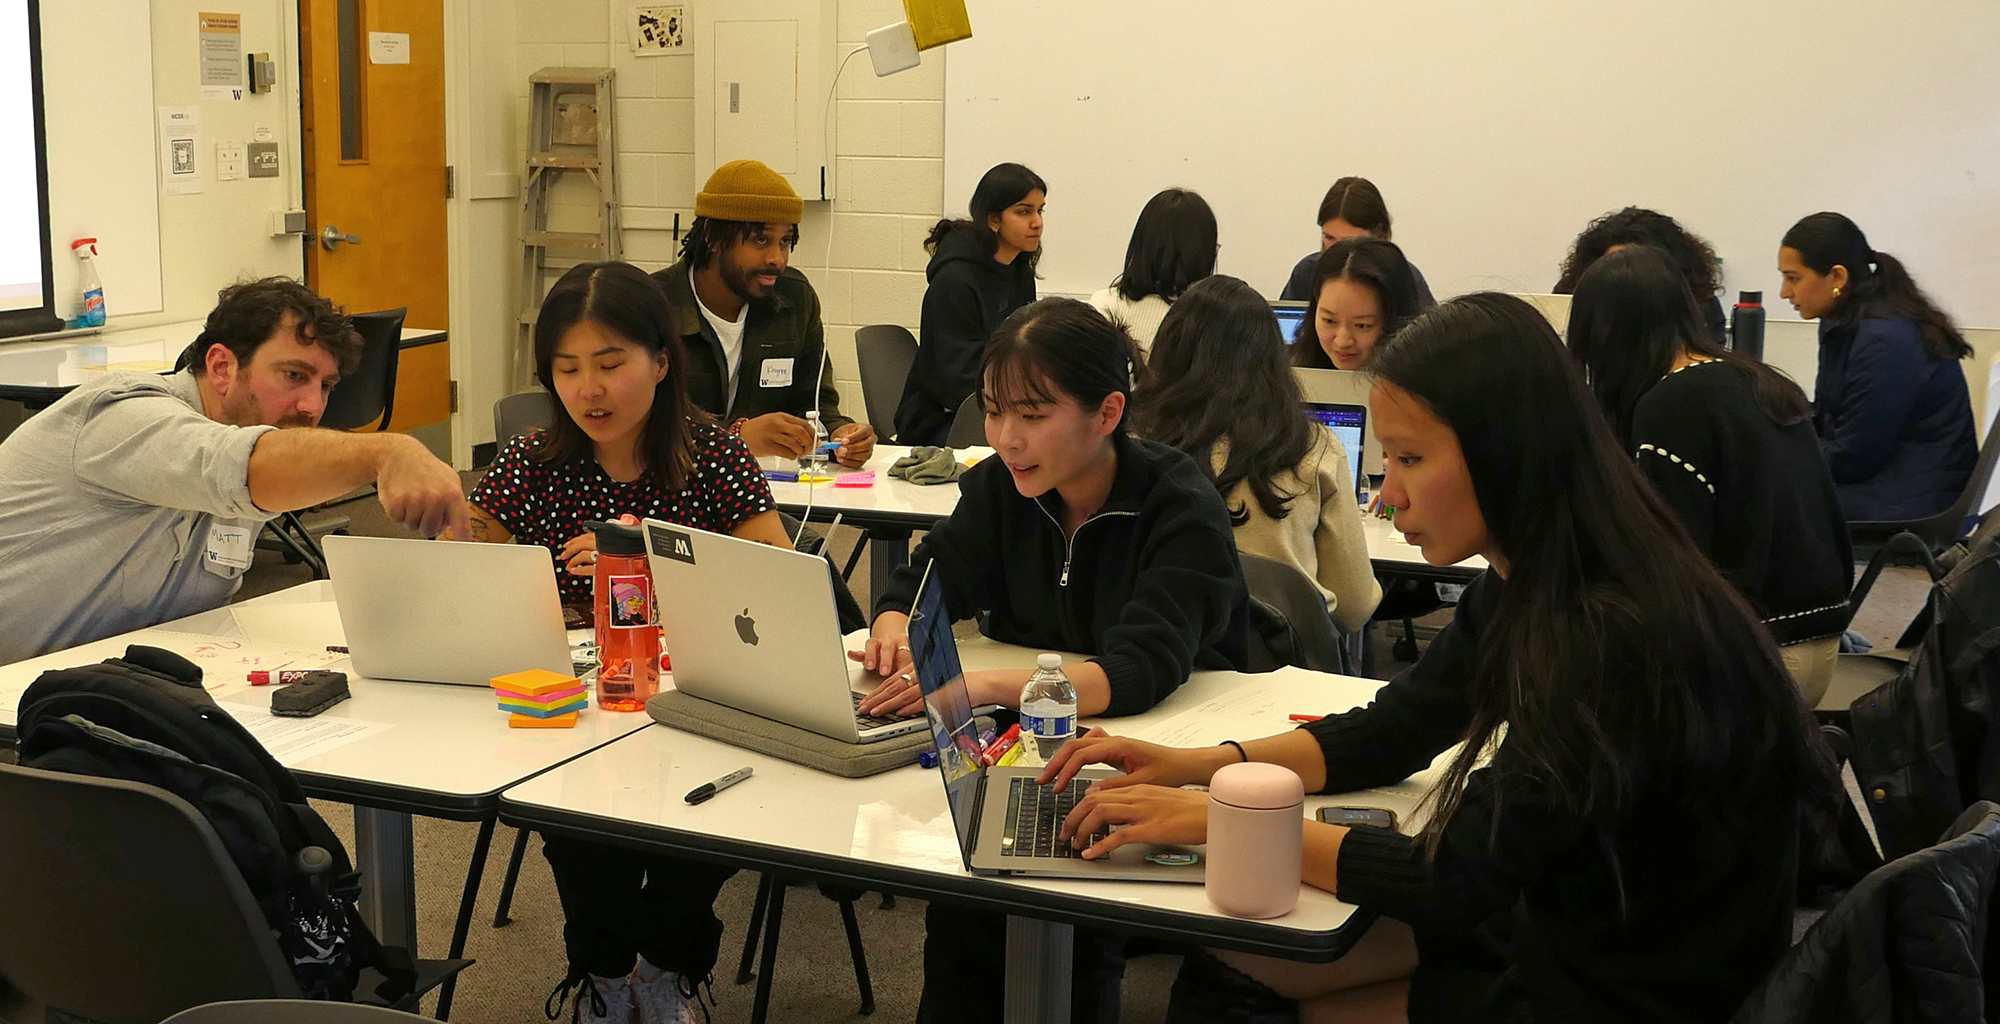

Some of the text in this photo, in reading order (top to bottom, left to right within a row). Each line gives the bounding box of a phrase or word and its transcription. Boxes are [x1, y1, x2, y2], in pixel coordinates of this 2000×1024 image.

[232, 89, 242, 100] W
[211, 529, 242, 544] MATT
[209, 550, 218, 561] W
